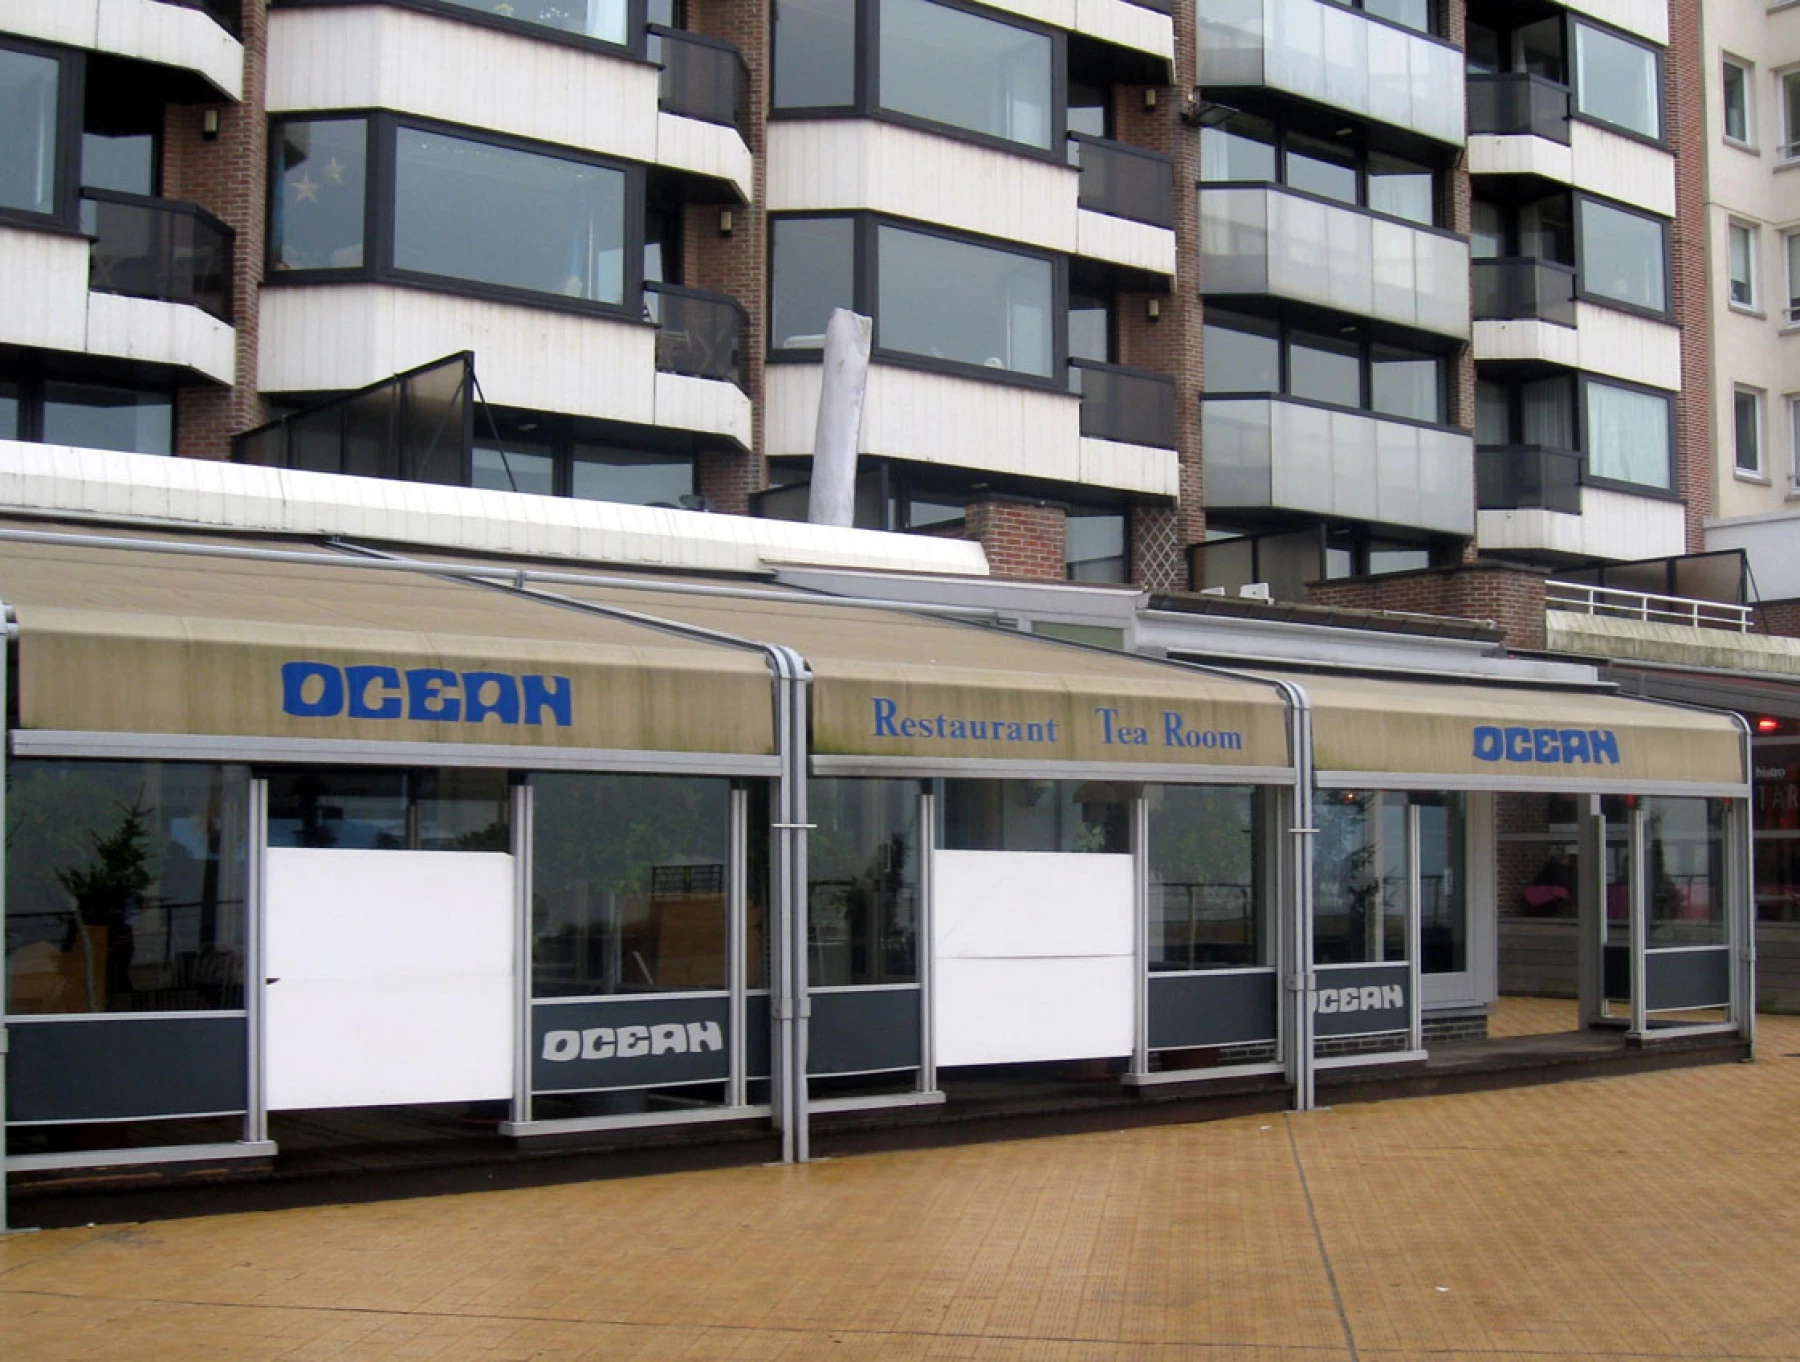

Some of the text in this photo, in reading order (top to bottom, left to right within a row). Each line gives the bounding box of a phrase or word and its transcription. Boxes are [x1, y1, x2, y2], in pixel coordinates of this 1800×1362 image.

[281, 661, 572, 726] OCEAN
[872, 697, 1242, 749] Restaurant Tea Room
[1473, 725, 1620, 764] OCEAN
[542, 1021, 723, 1062] OCEAN
